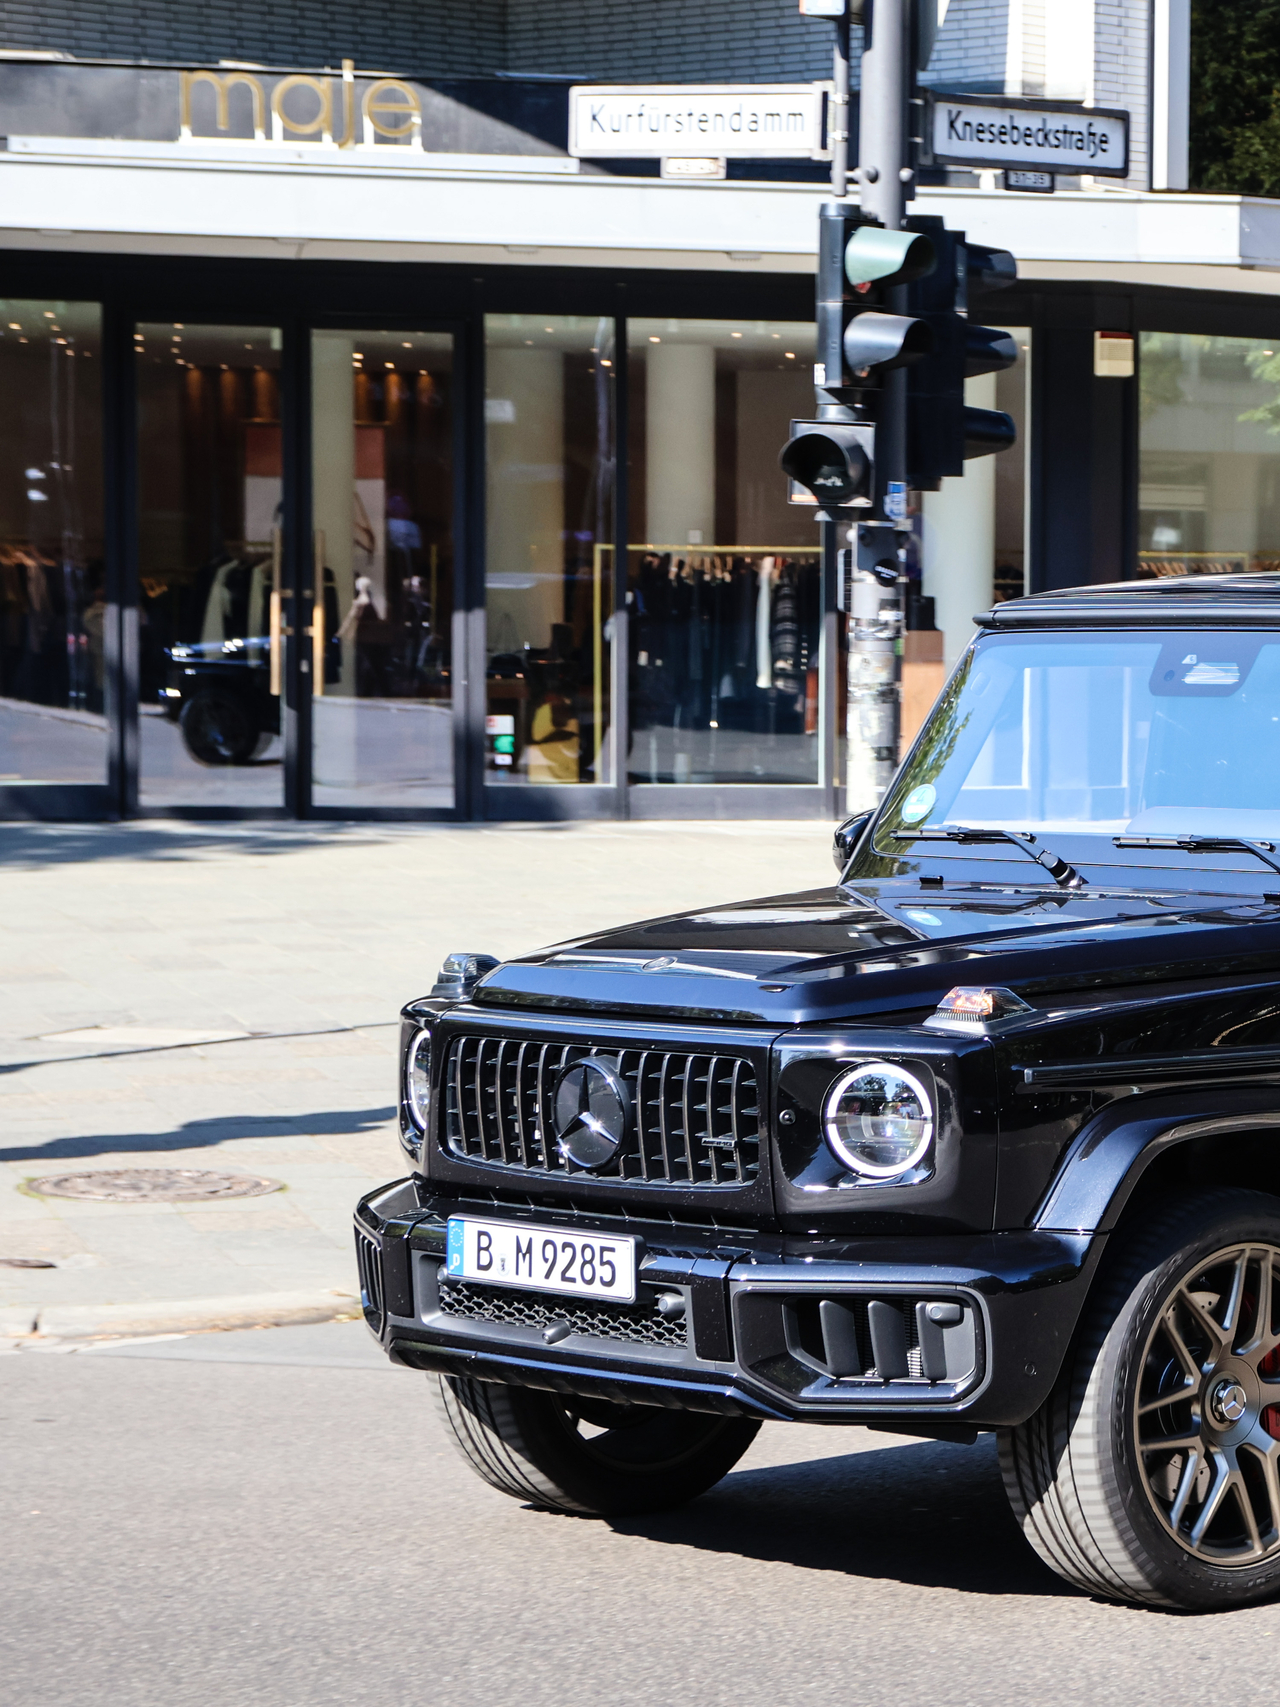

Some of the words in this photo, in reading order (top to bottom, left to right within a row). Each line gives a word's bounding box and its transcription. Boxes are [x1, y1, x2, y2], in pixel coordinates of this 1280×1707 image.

[179, 58, 422, 150] maje
[589, 103, 805, 134] Kurfürstendamm
[947, 108, 1110, 159] Knesebeckstraße
[452, 1253, 461, 1267] D
[477, 1230, 493, 1272] B
